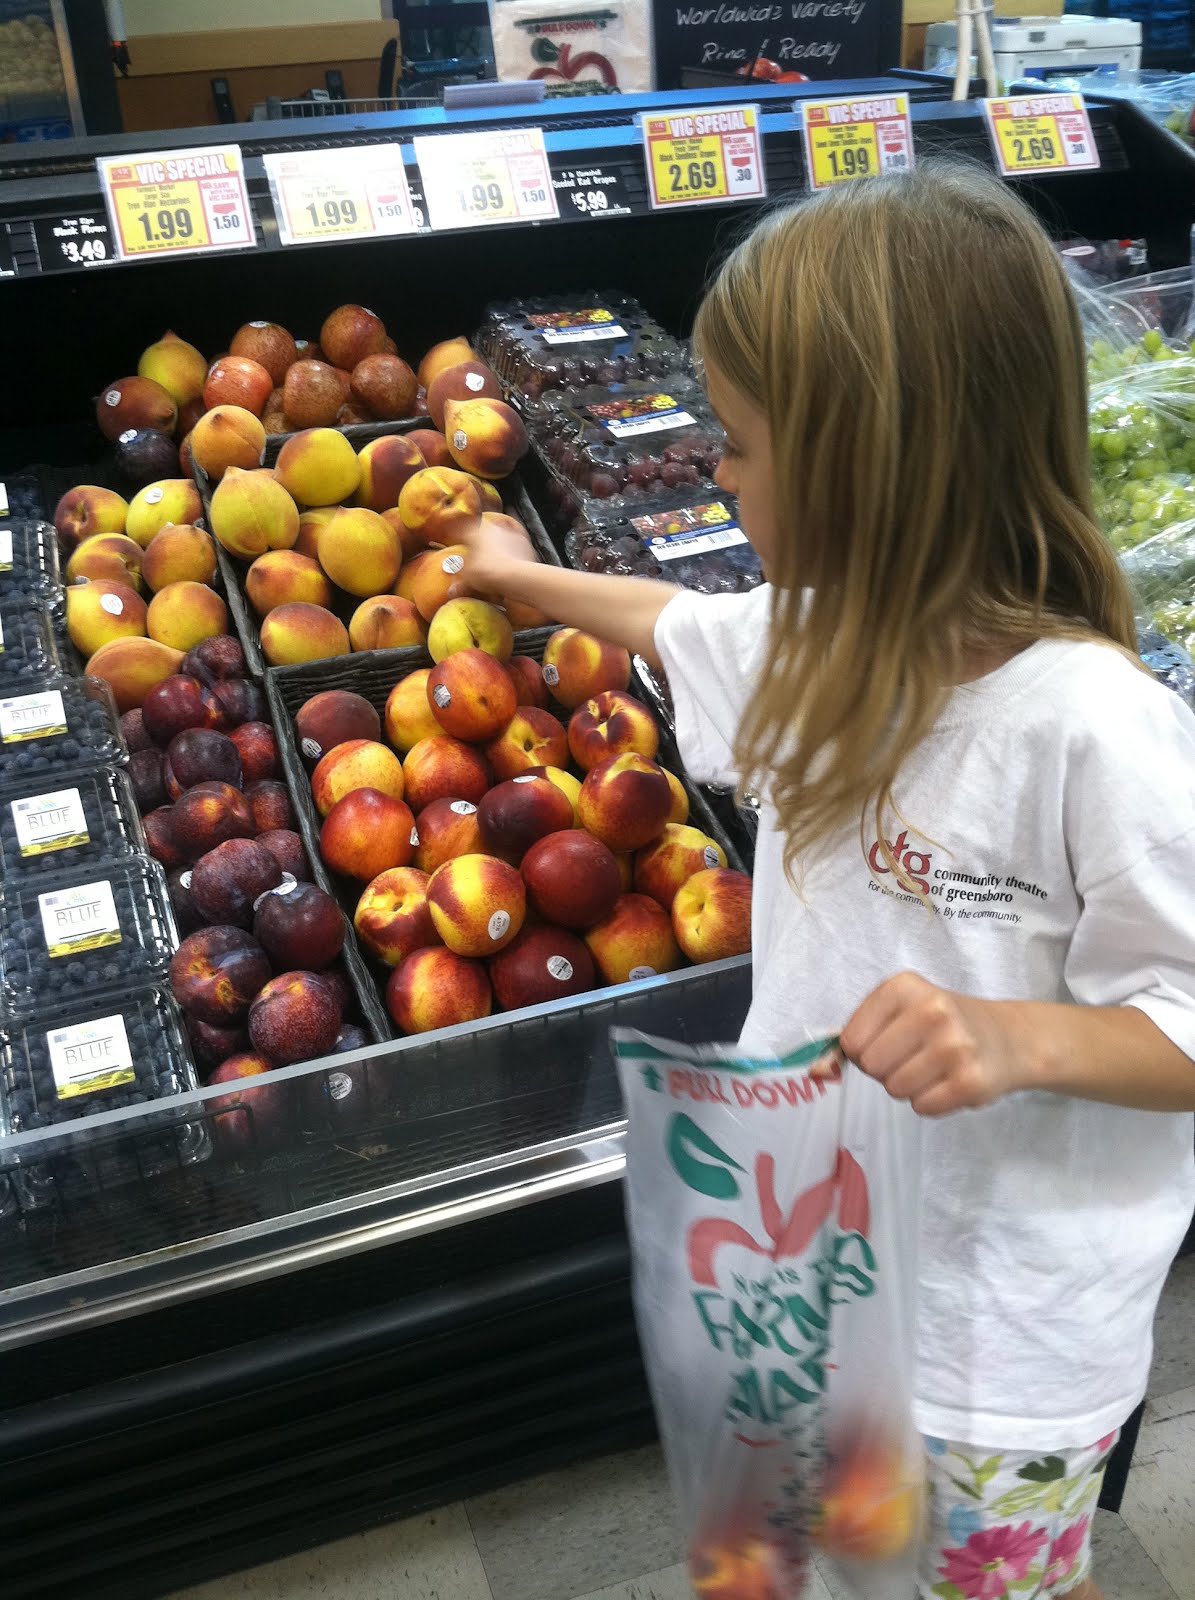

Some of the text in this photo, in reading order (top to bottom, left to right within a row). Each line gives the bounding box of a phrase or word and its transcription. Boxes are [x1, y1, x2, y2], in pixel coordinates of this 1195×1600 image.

[676, 4, 783, 26] Worldwide
[779, 37, 841, 64] Ready
[827, 99, 899, 124] VIC SPECIAL
[1008, 96, 1074, 117] VIC SPECIAL
[669, 110, 748, 138] VIC SPECIAL
[1013, 137, 1055, 161] 2.69
[135, 153, 229, 185] VIC SPECIAL
[827, 147, 870, 176] 1.99
[668, 161, 717, 192] 2.69
[735, 168, 752, 181] .30
[457, 183, 504, 212] 1.99
[522, 189, 546, 202] 1.50
[571, 190, 608, 212] $5.99
[213, 214, 240, 230] 1.50
[306, 199, 358, 227] 1.99
[377, 204, 403, 218] 1.50
[138, 208, 193, 241] 1.99
[61, 239, 106, 262] $3.49
[11, 704, 50, 722] BLUE
[28, 807, 72, 830] BLUE
[931, 883, 1013, 903] of greensboro
[934, 869, 1048, 900] community theatre
[868, 880, 880, 892] For
[943, 907, 956, 920] By
[958, 907, 972, 919] the
[972, 910, 1022, 925] community.
[56, 903, 101, 927] BLUE
[65, 1039, 113, 1065] BLUE
